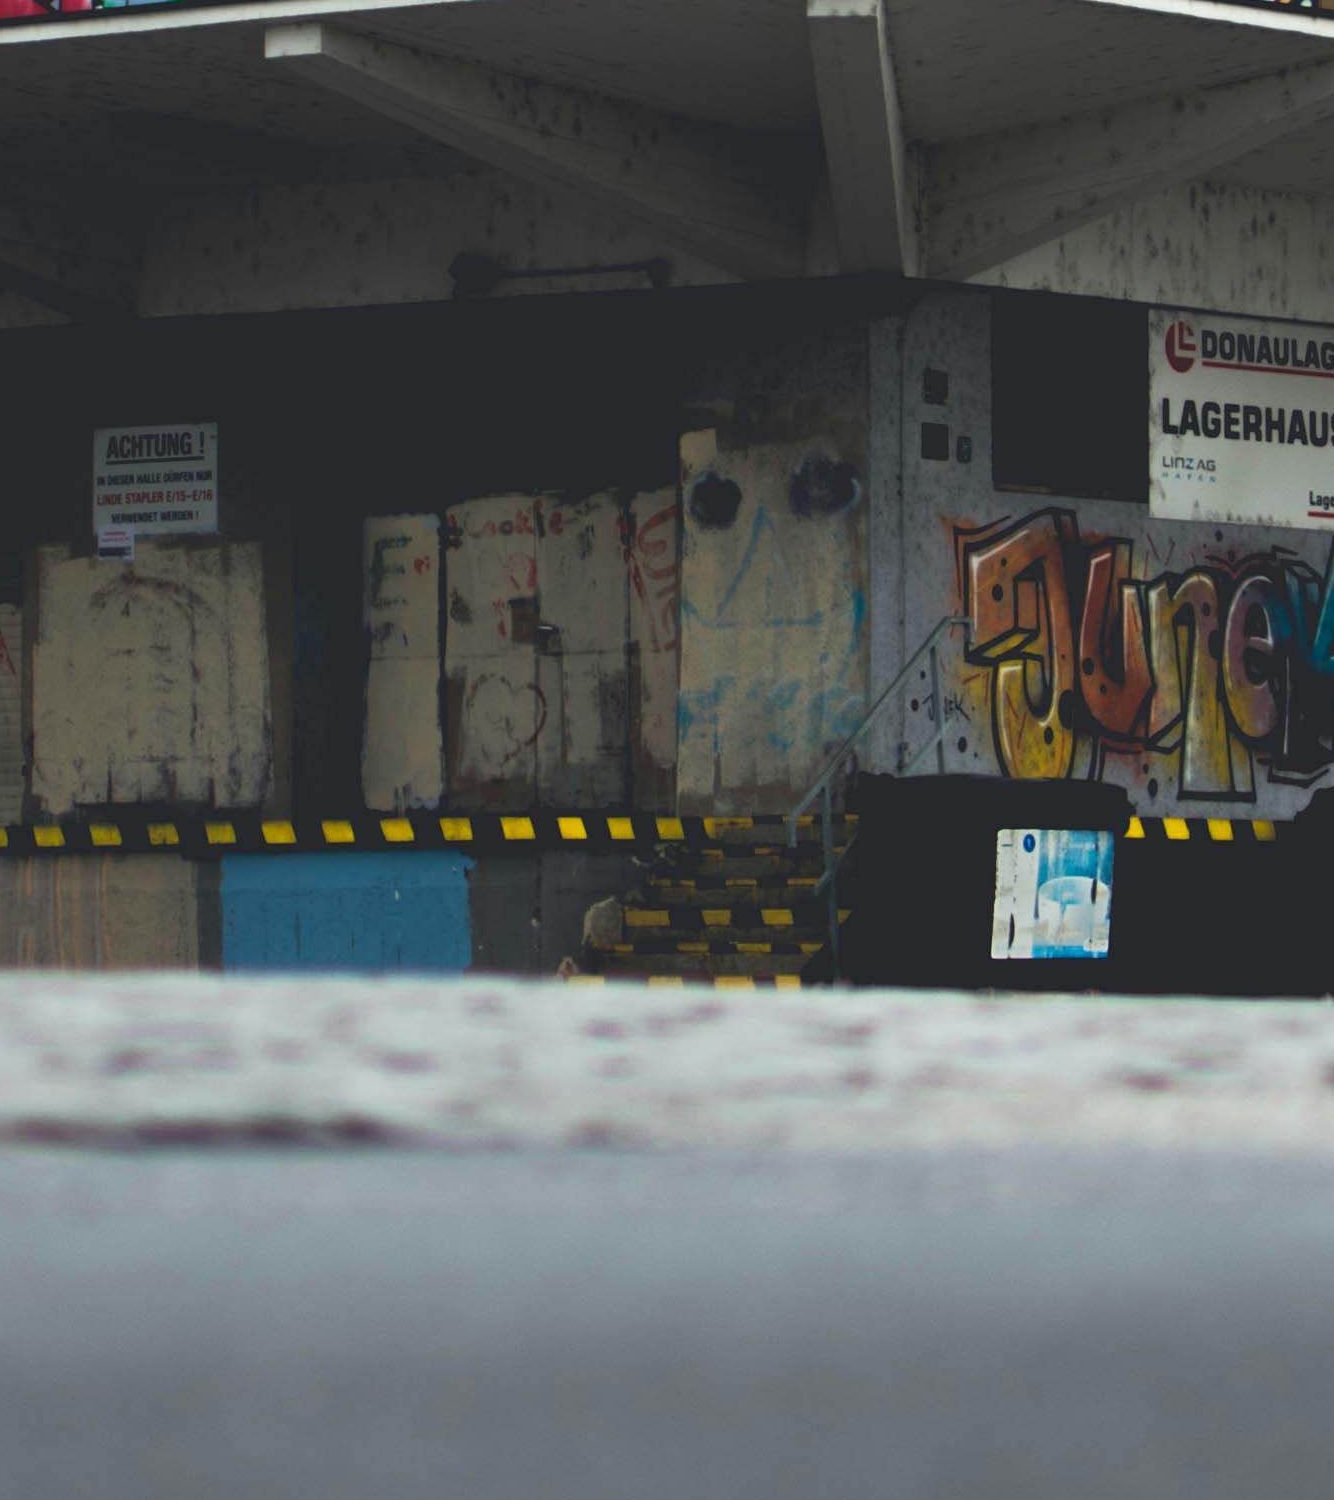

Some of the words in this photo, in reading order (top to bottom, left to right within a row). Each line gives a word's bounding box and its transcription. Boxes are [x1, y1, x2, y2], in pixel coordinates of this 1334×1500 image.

[106, 432, 192, 459] ACHTUNG
[1196, 459, 1216, 472] AG
[97, 493, 122, 505] LINDE
[125, 491, 163, 505] STAPLER
